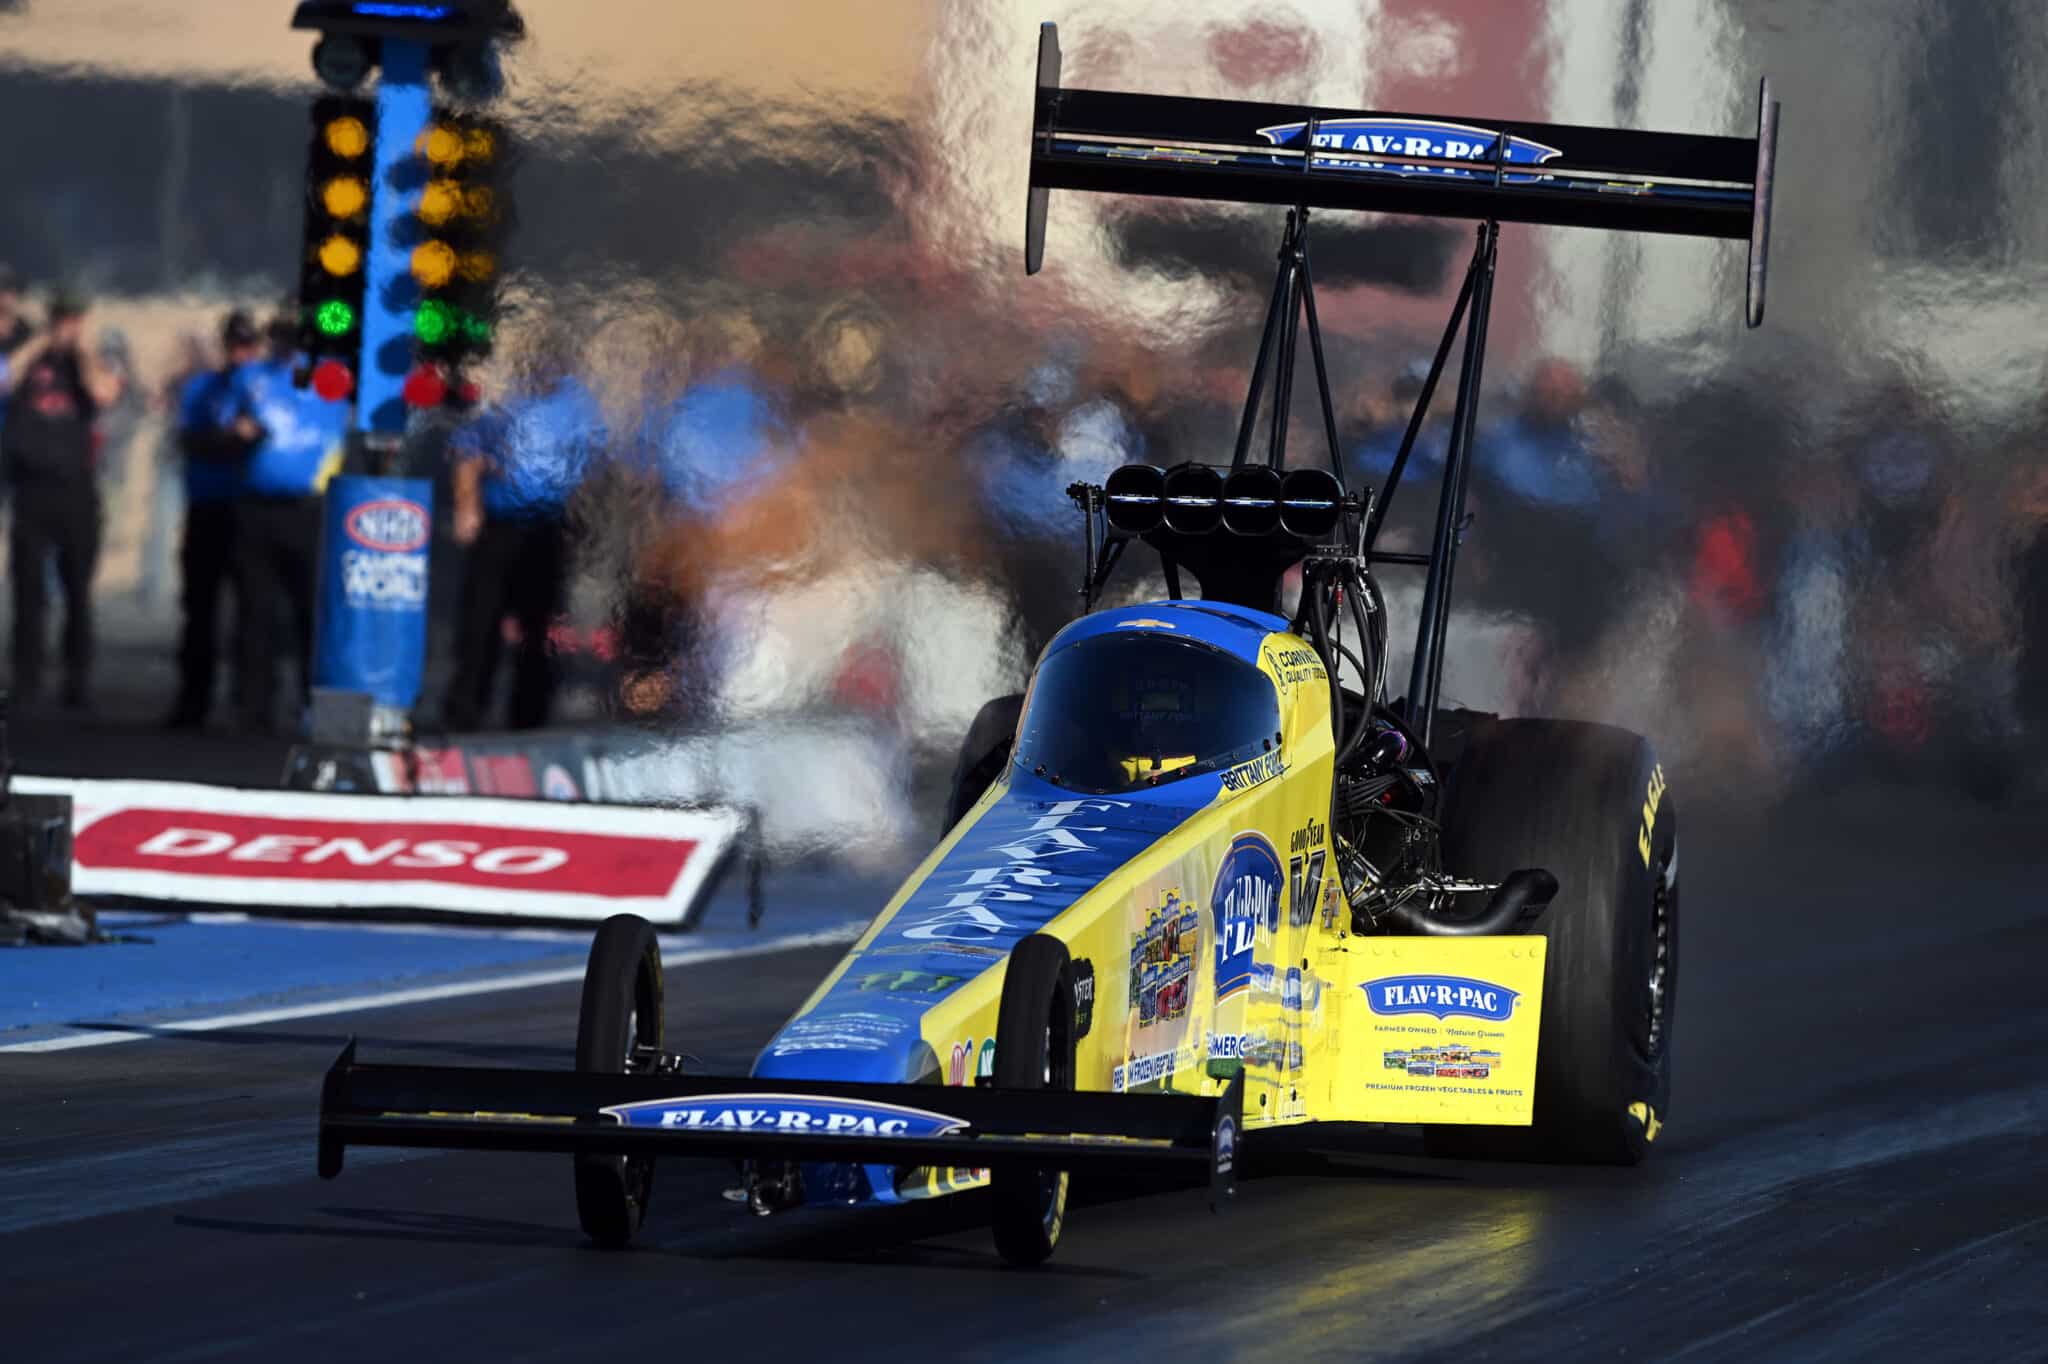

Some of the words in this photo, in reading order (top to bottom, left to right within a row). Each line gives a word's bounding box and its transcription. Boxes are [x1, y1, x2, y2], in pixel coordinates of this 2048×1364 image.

[1220, 759, 1266, 792] BRITTANY
[136, 828, 569, 875] DENSO
[1374, 1024, 1406, 1033] FARMER
[1407, 1026, 1437, 1035] OWNED
[1365, 1082, 1403, 1091] PREMIUM
[1404, 1084, 1436, 1092] FROZEN
[1437, 1085, 1487, 1095] VEGETABLES
[1495, 1088, 1523, 1097] FRUITS
